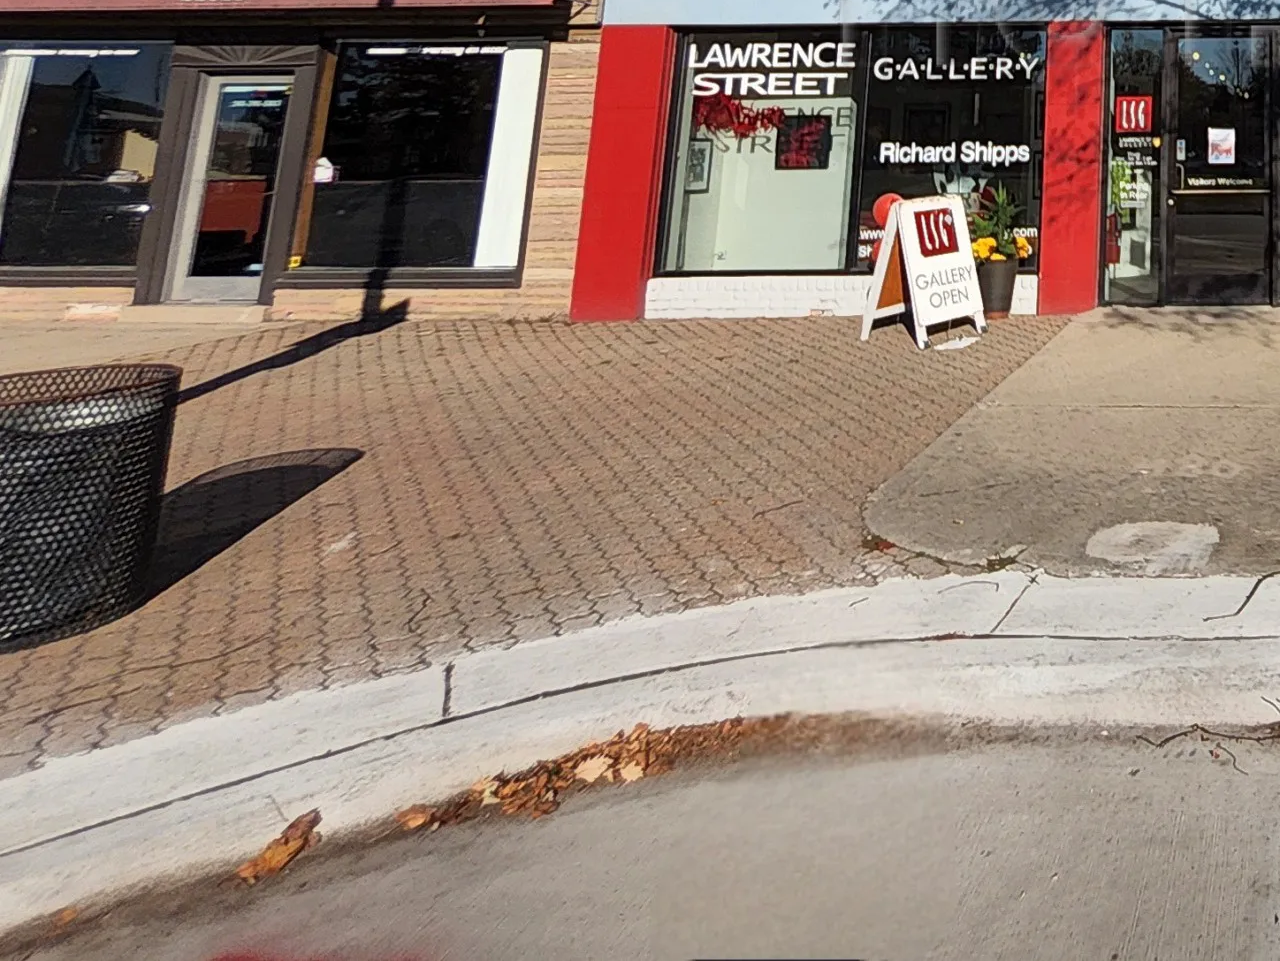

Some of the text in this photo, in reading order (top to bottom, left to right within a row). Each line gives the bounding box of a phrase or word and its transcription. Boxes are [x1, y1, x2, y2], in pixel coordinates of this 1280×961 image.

[689, 42, 856, 69] LAWRENCE
[691, 72, 849, 97] STREET
[880, 140, 1031, 168] Richard Shipps
[915, 265, 974, 290] GALLERY
[929, 288, 970, 309] OPEN
